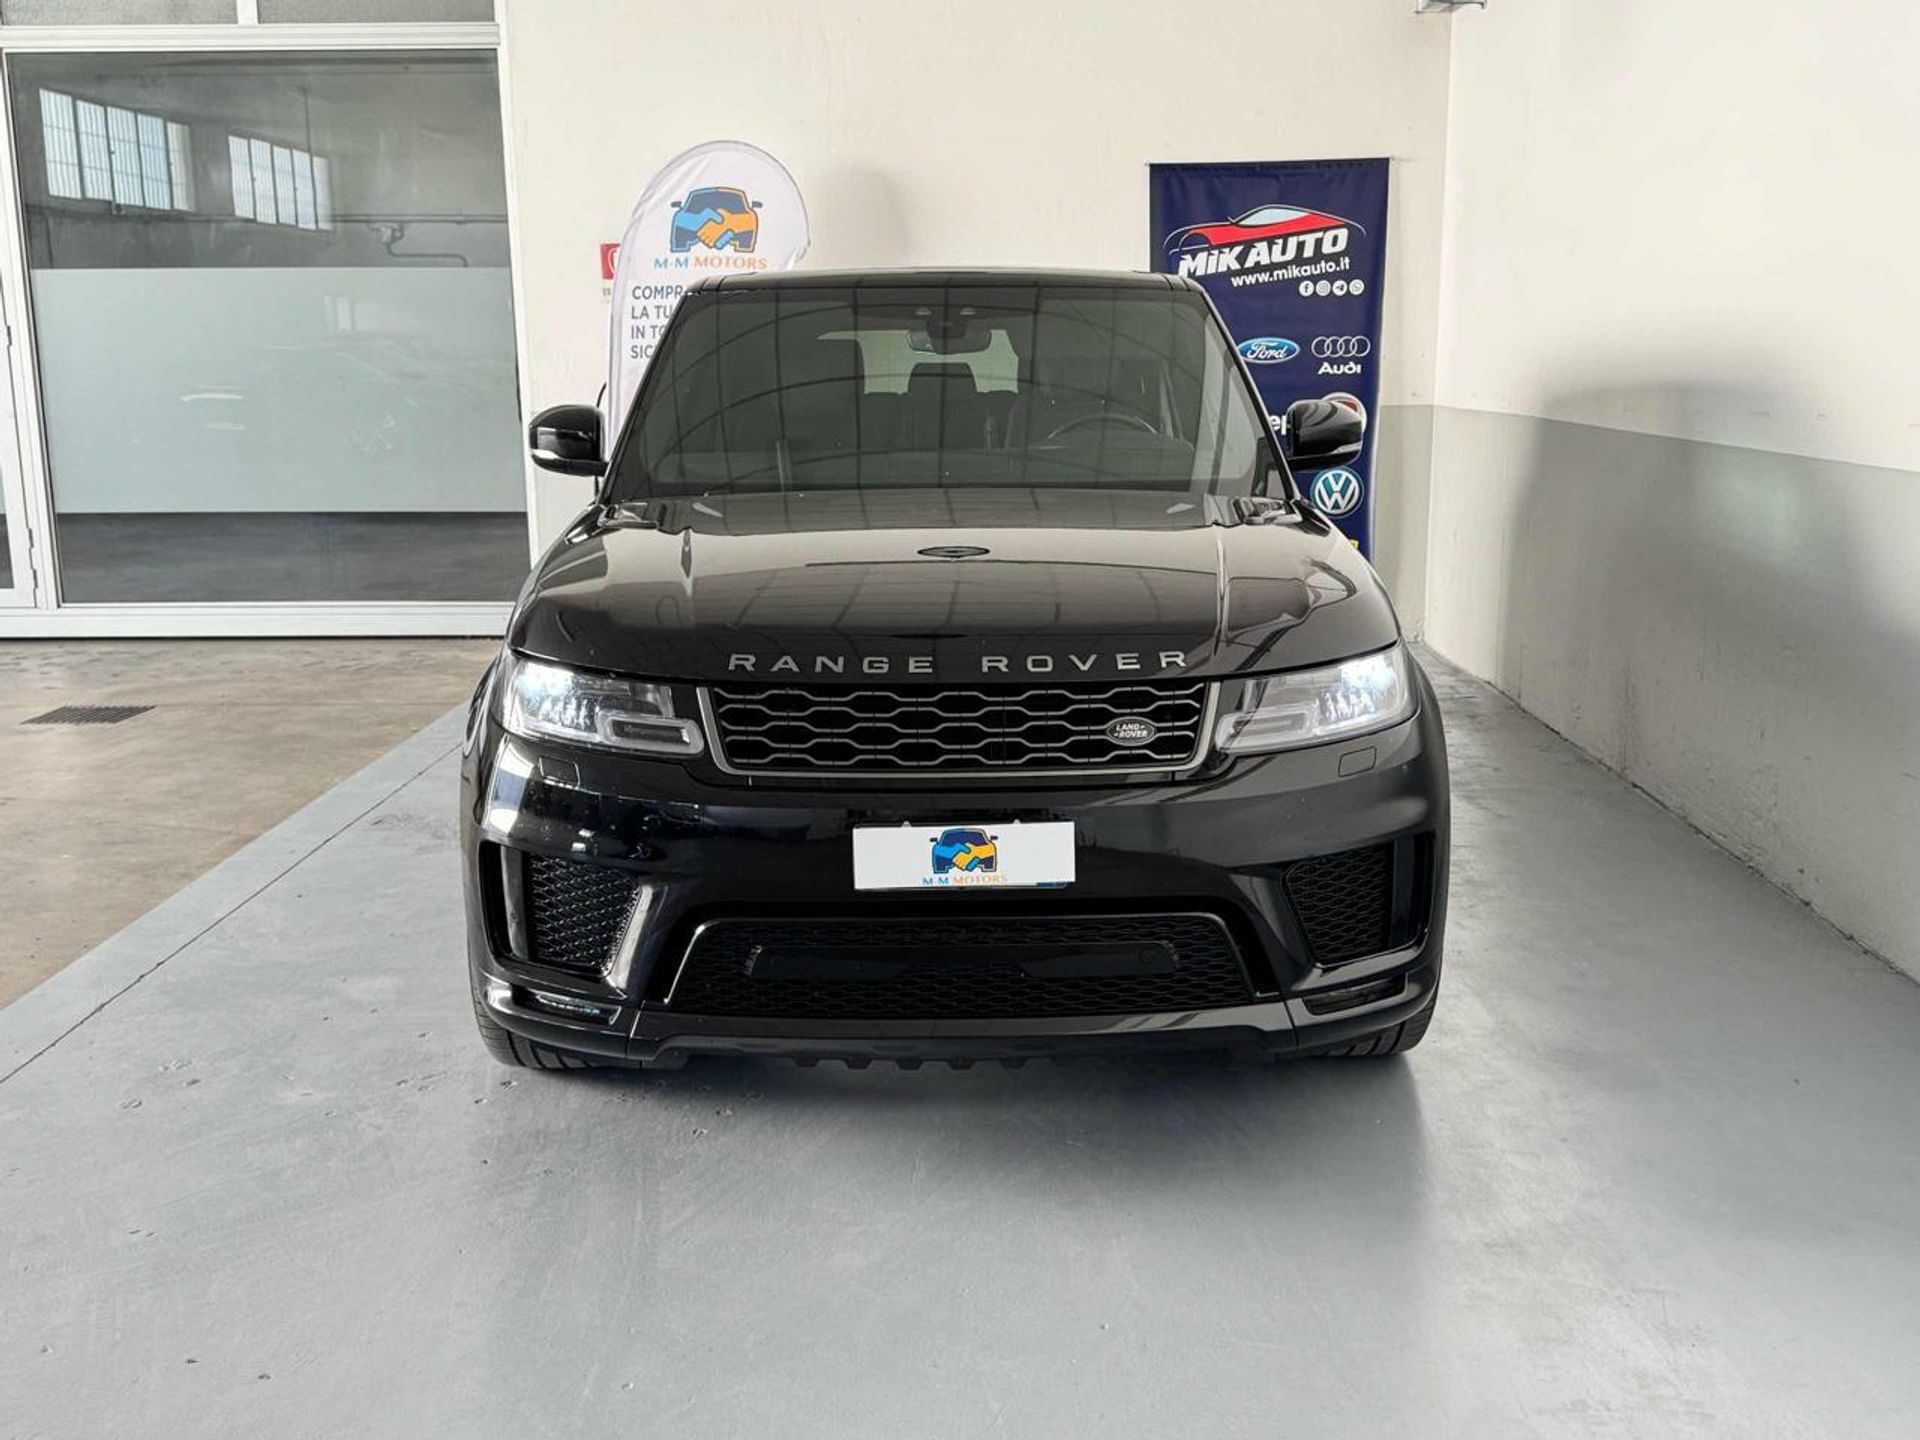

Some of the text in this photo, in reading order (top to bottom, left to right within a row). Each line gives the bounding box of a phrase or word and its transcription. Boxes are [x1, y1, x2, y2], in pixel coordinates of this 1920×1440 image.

[1244, 227, 1349, 268] AUTO
[694, 255, 768, 270] MOTORS
[1231, 256, 1350, 287] www.mikauto.it
[631, 305, 649, 319] LA
[631, 325, 646, 339] IN
[1246, 343, 1288, 360] Ford
[1317, 361, 1362, 375] Audi
[727, 651, 1188, 674] RANGE ROVER
